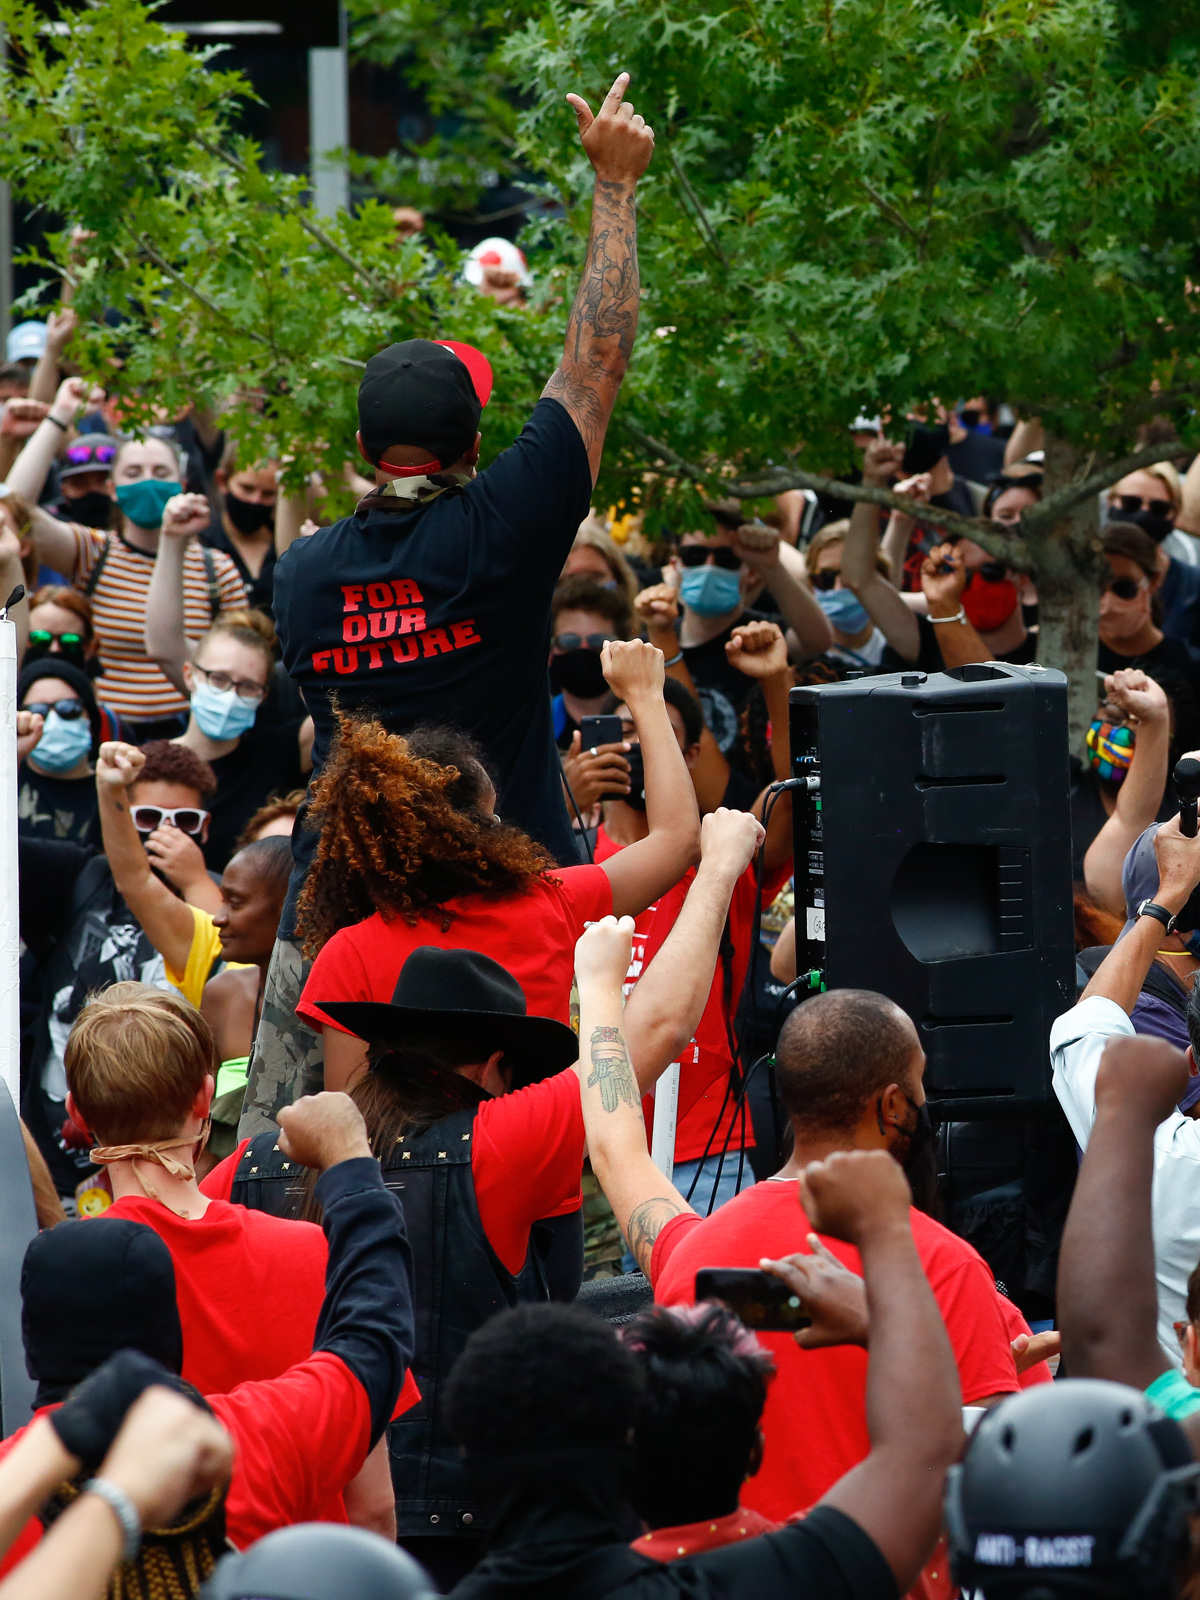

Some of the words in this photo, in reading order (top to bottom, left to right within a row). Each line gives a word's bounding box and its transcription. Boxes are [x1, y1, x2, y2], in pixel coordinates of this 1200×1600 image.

[340, 578, 424, 613] FOR
[342, 607, 427, 643] OUR
[311, 619, 482, 675] FUTURE
[974, 1532, 1096, 1568] ANTI-RACIST
